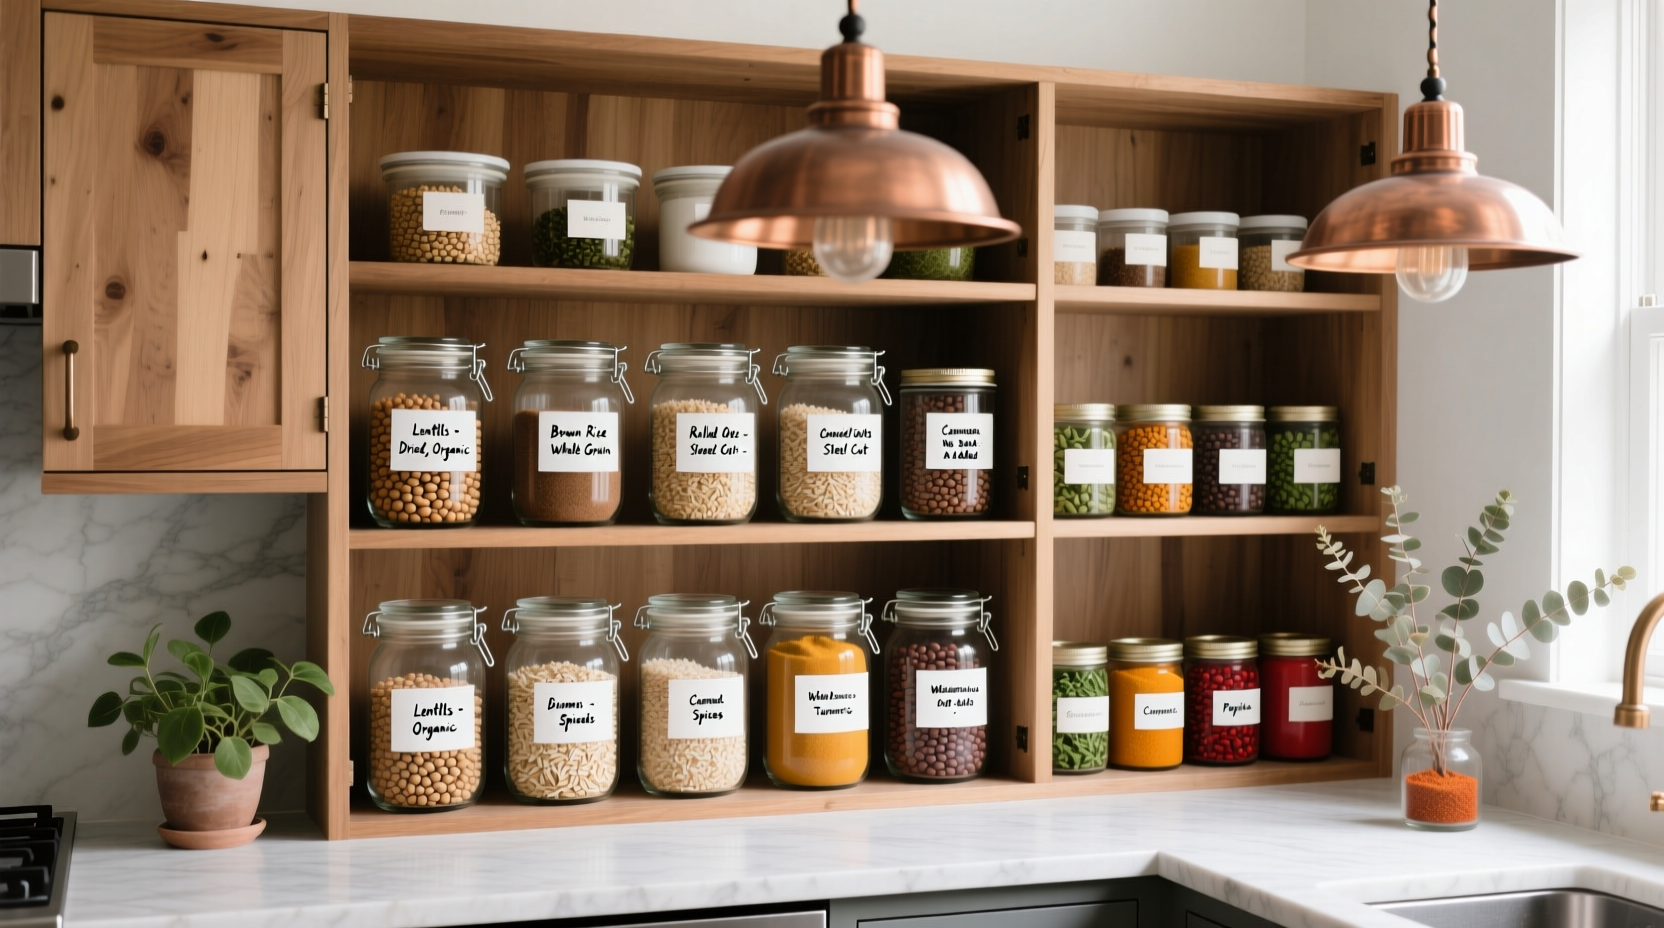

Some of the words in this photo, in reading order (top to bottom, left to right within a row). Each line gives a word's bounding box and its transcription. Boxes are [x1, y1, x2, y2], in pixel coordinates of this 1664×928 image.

[433, 442, 470, 461] Organic
[851, 443, 869, 455] Cut
[693, 709, 723, 725] Spices
[412, 721, 457, 741] Organic
